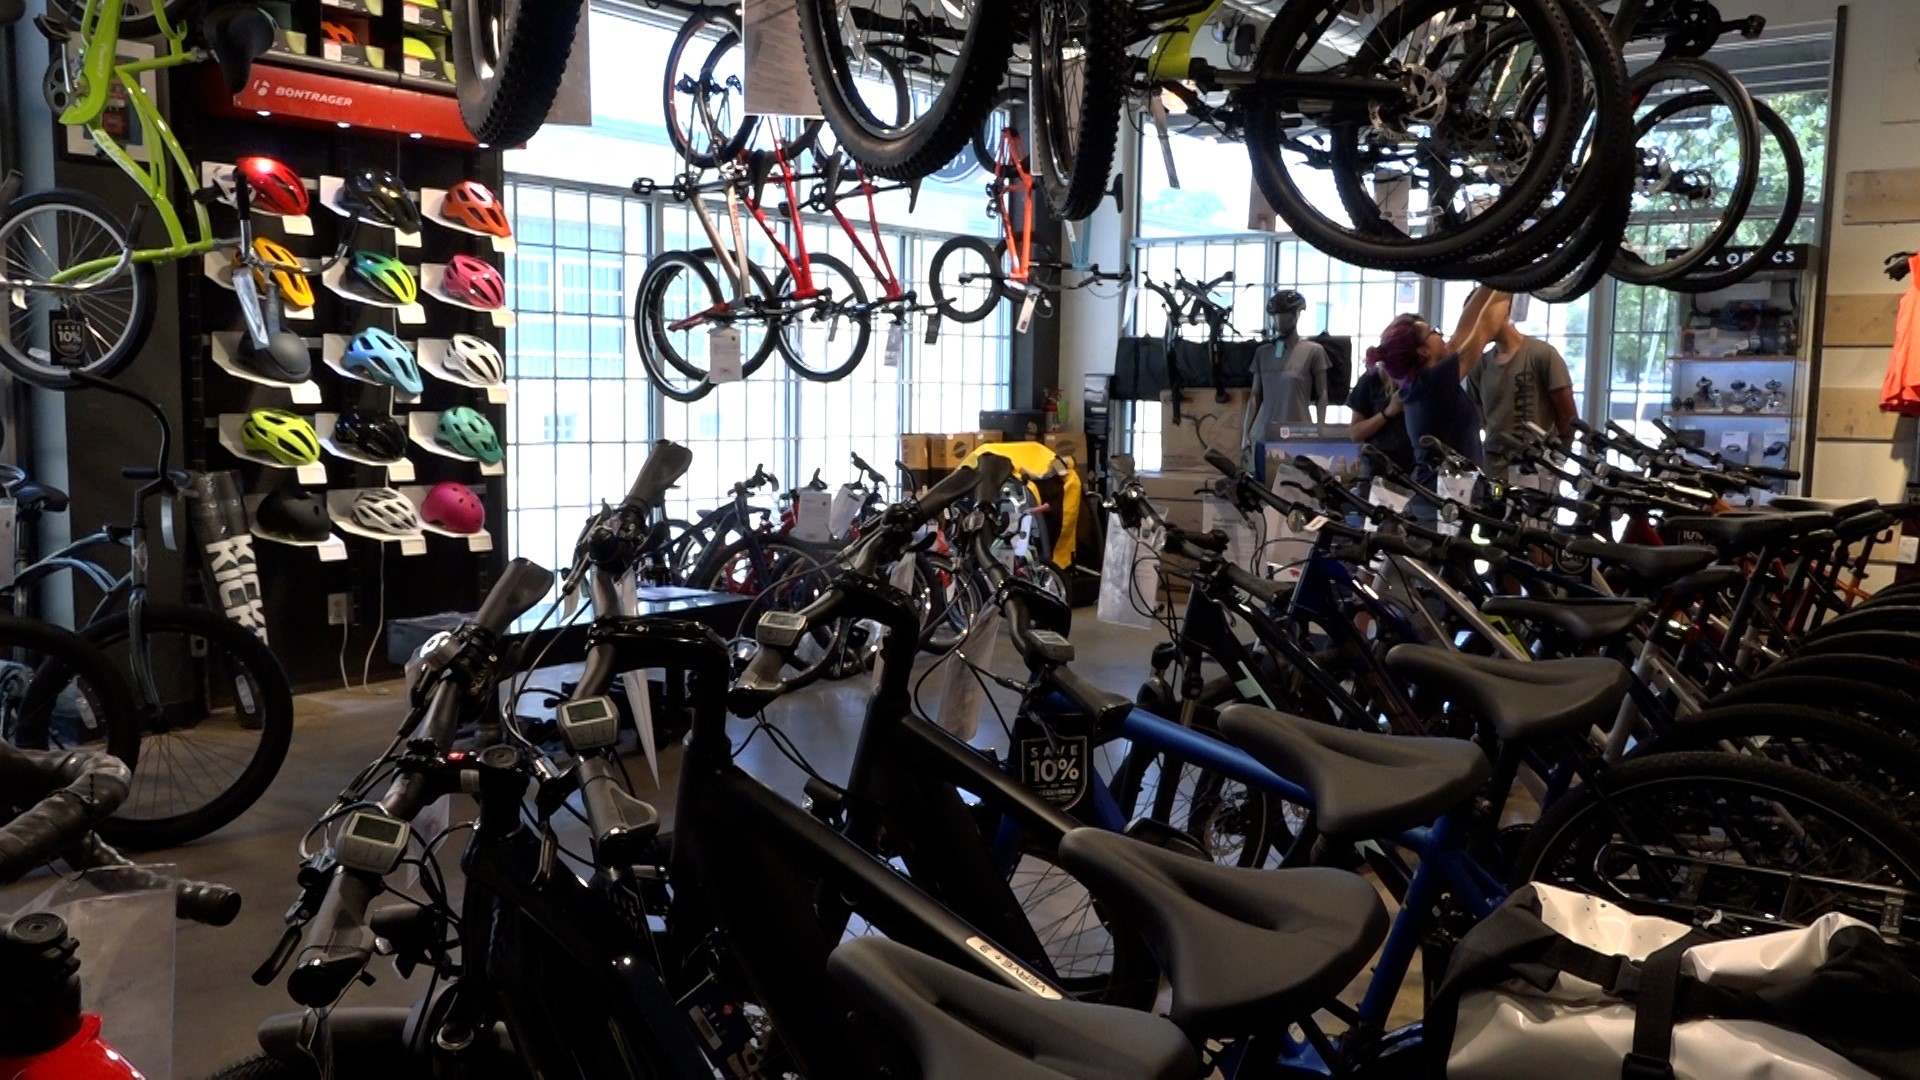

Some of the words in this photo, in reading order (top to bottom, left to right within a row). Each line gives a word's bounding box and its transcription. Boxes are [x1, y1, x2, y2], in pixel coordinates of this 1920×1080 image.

[275, 86, 353, 106] BONTRAGER
[57, 331, 82, 343] 10%
[1030, 757, 1080, 782] 10%
